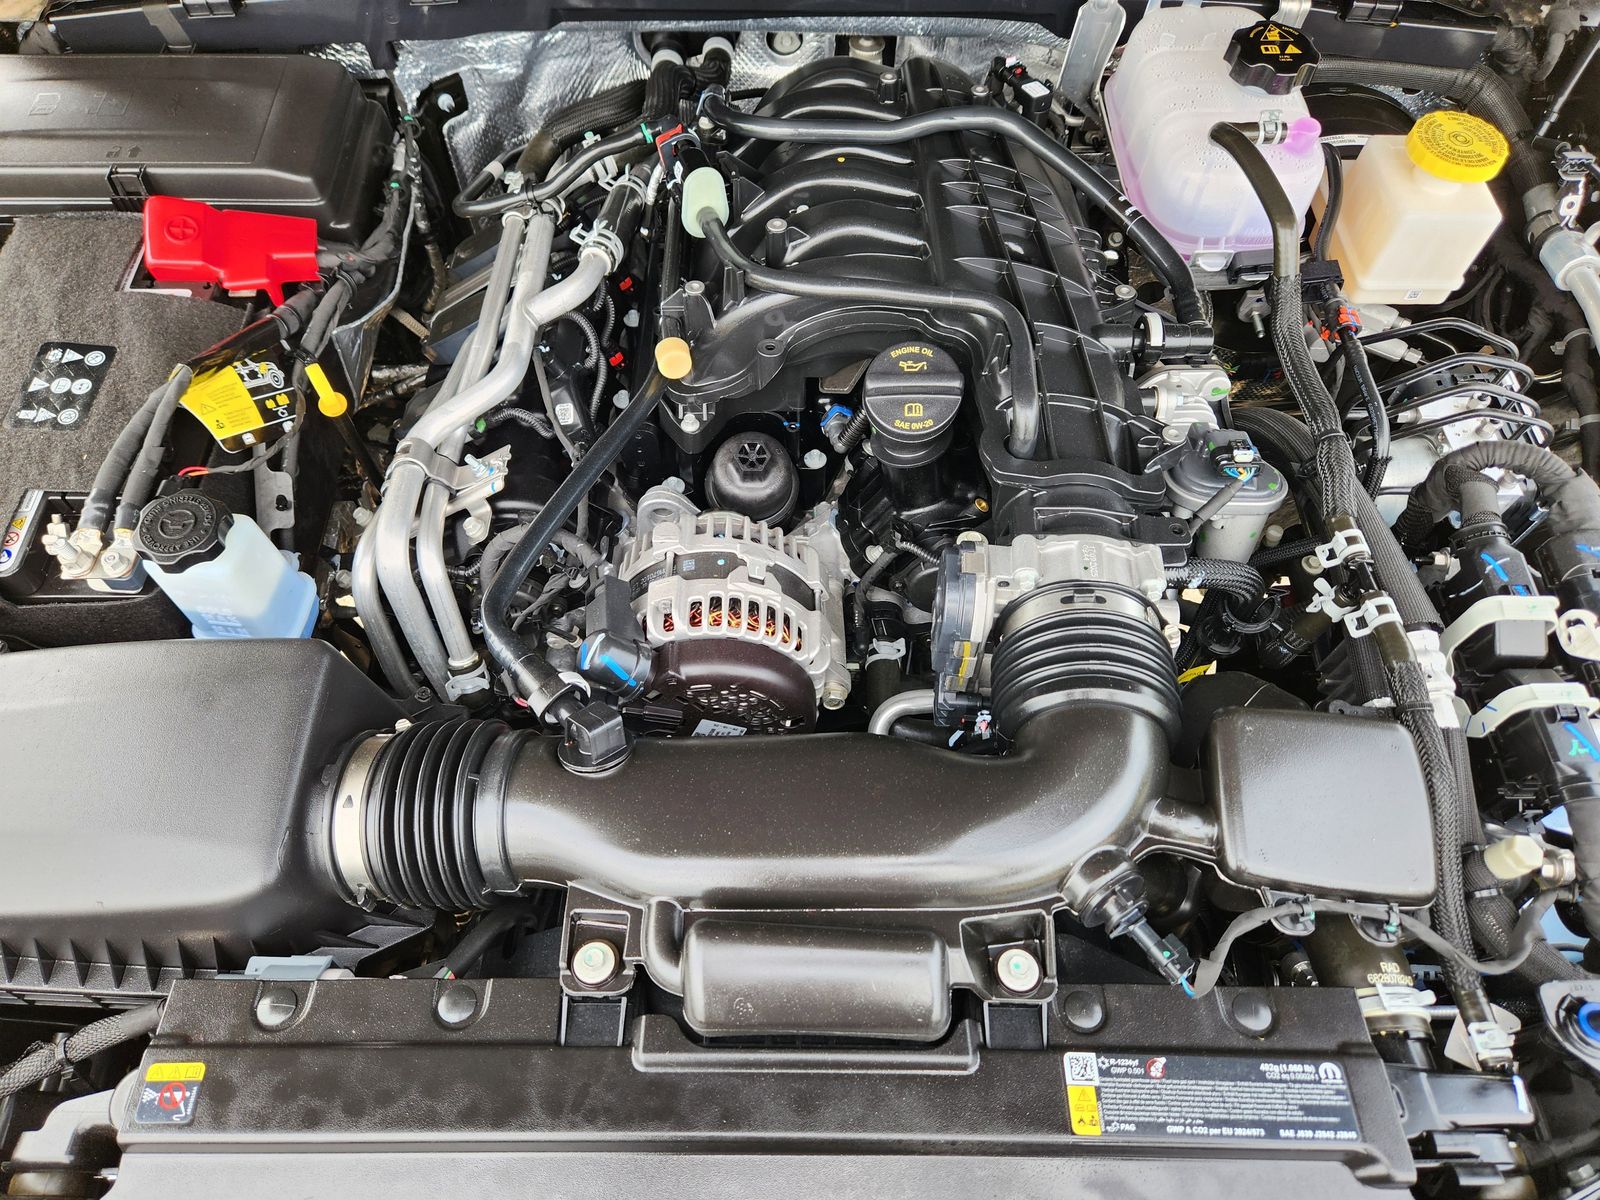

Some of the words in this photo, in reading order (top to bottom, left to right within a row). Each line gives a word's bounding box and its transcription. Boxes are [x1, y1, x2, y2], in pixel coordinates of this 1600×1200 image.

[890, 346, 920, 358] ENGINE
[921, 347, 934, 357] OIL
[894, 419, 910, 430] SAE
[911, 419, 934, 430] 0W-20
[162, 495, 201, 507] STEERING
[144, 505, 161, 525] FLUID
[143, 534, 181, 552] APPROVED
[185, 535, 200, 546] USE
[1380, 961, 1400, 973] RAD
[1303, 1064, 1316, 1074] lb)
[1120, 1123, 1136, 1132] PAG
[1166, 1125, 1184, 1134] GWP
[1185, 1126, 1192, 1134] &
[1192, 1126, 1208, 1135] CO2
[1209, 1128, 1221, 1136] per
[1222, 1127, 1233, 1136] EU
[1279, 1128, 1295, 1138] SAE
